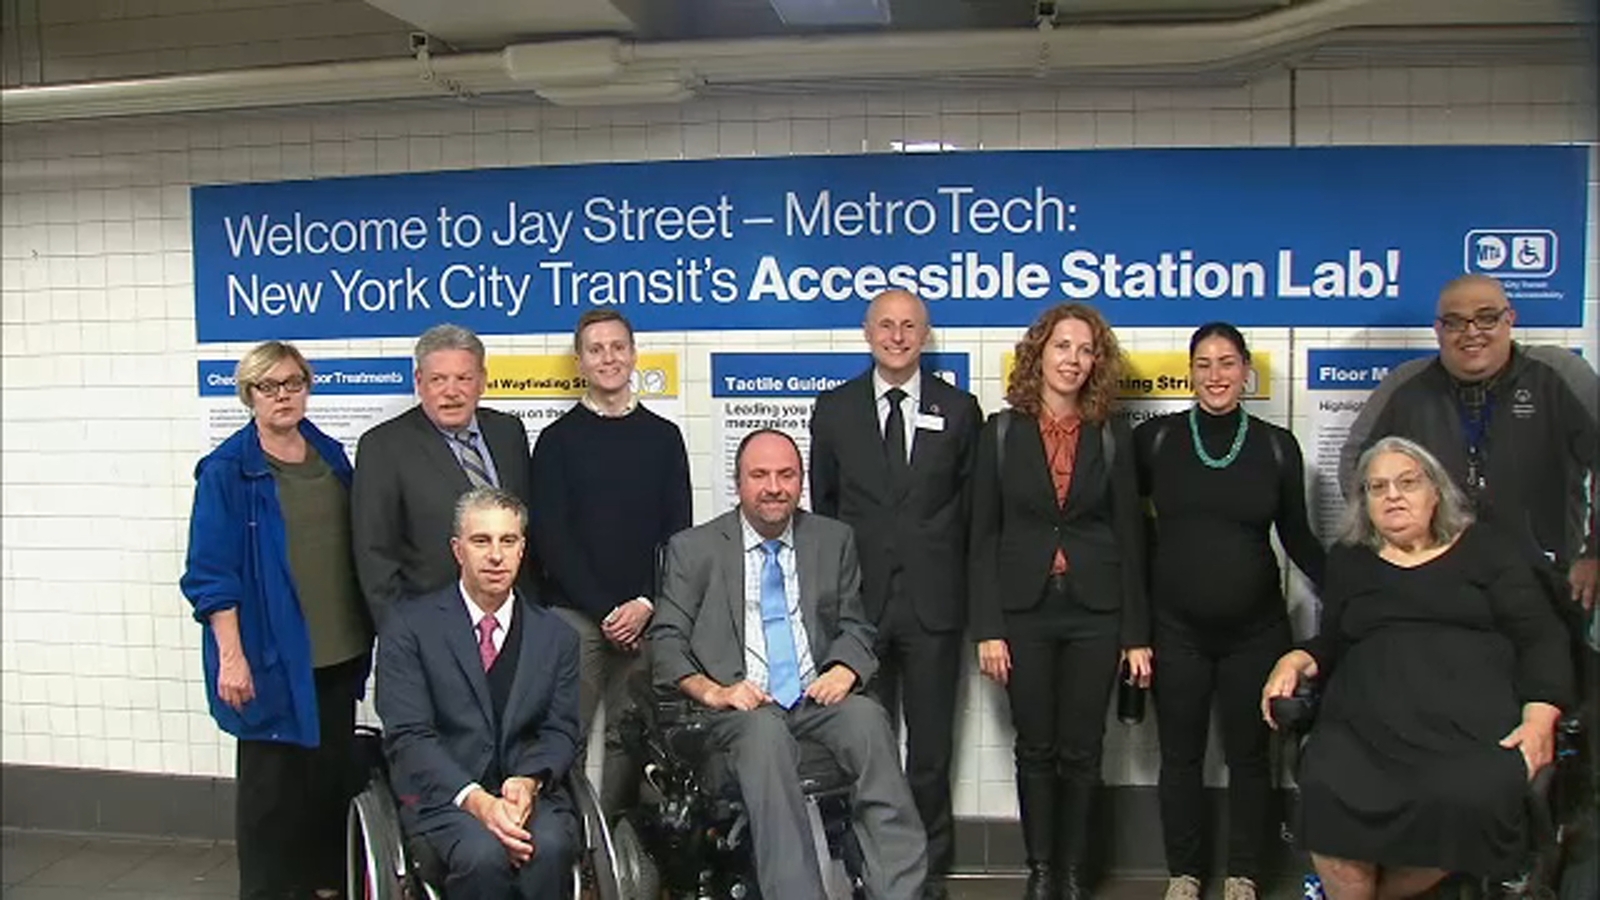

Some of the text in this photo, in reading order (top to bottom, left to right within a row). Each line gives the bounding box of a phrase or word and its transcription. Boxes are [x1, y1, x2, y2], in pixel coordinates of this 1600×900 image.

[224, 212, 427, 258] Welcome
[436, 206, 482, 248] to
[492, 201, 573, 254] Jay
[582, 196, 733, 242] Street
[785, 187, 1079, 236] MetroTech:
[227, 250, 1401, 317] New York City Transit’s Accessible Station Lab!
[207, 371, 404, 386] Chec oor Treatments
[1319, 367, 1389, 381] Floor M
[500, 378, 572, 390] Wayfinding
[572, 377, 588, 388] St
[724, 377, 784, 391] Tactile
[527, 409, 543, 418] on
[724, 402, 780, 417] Leading
[782, 405, 808, 417] you
[724, 418, 799, 430] mezzanine
